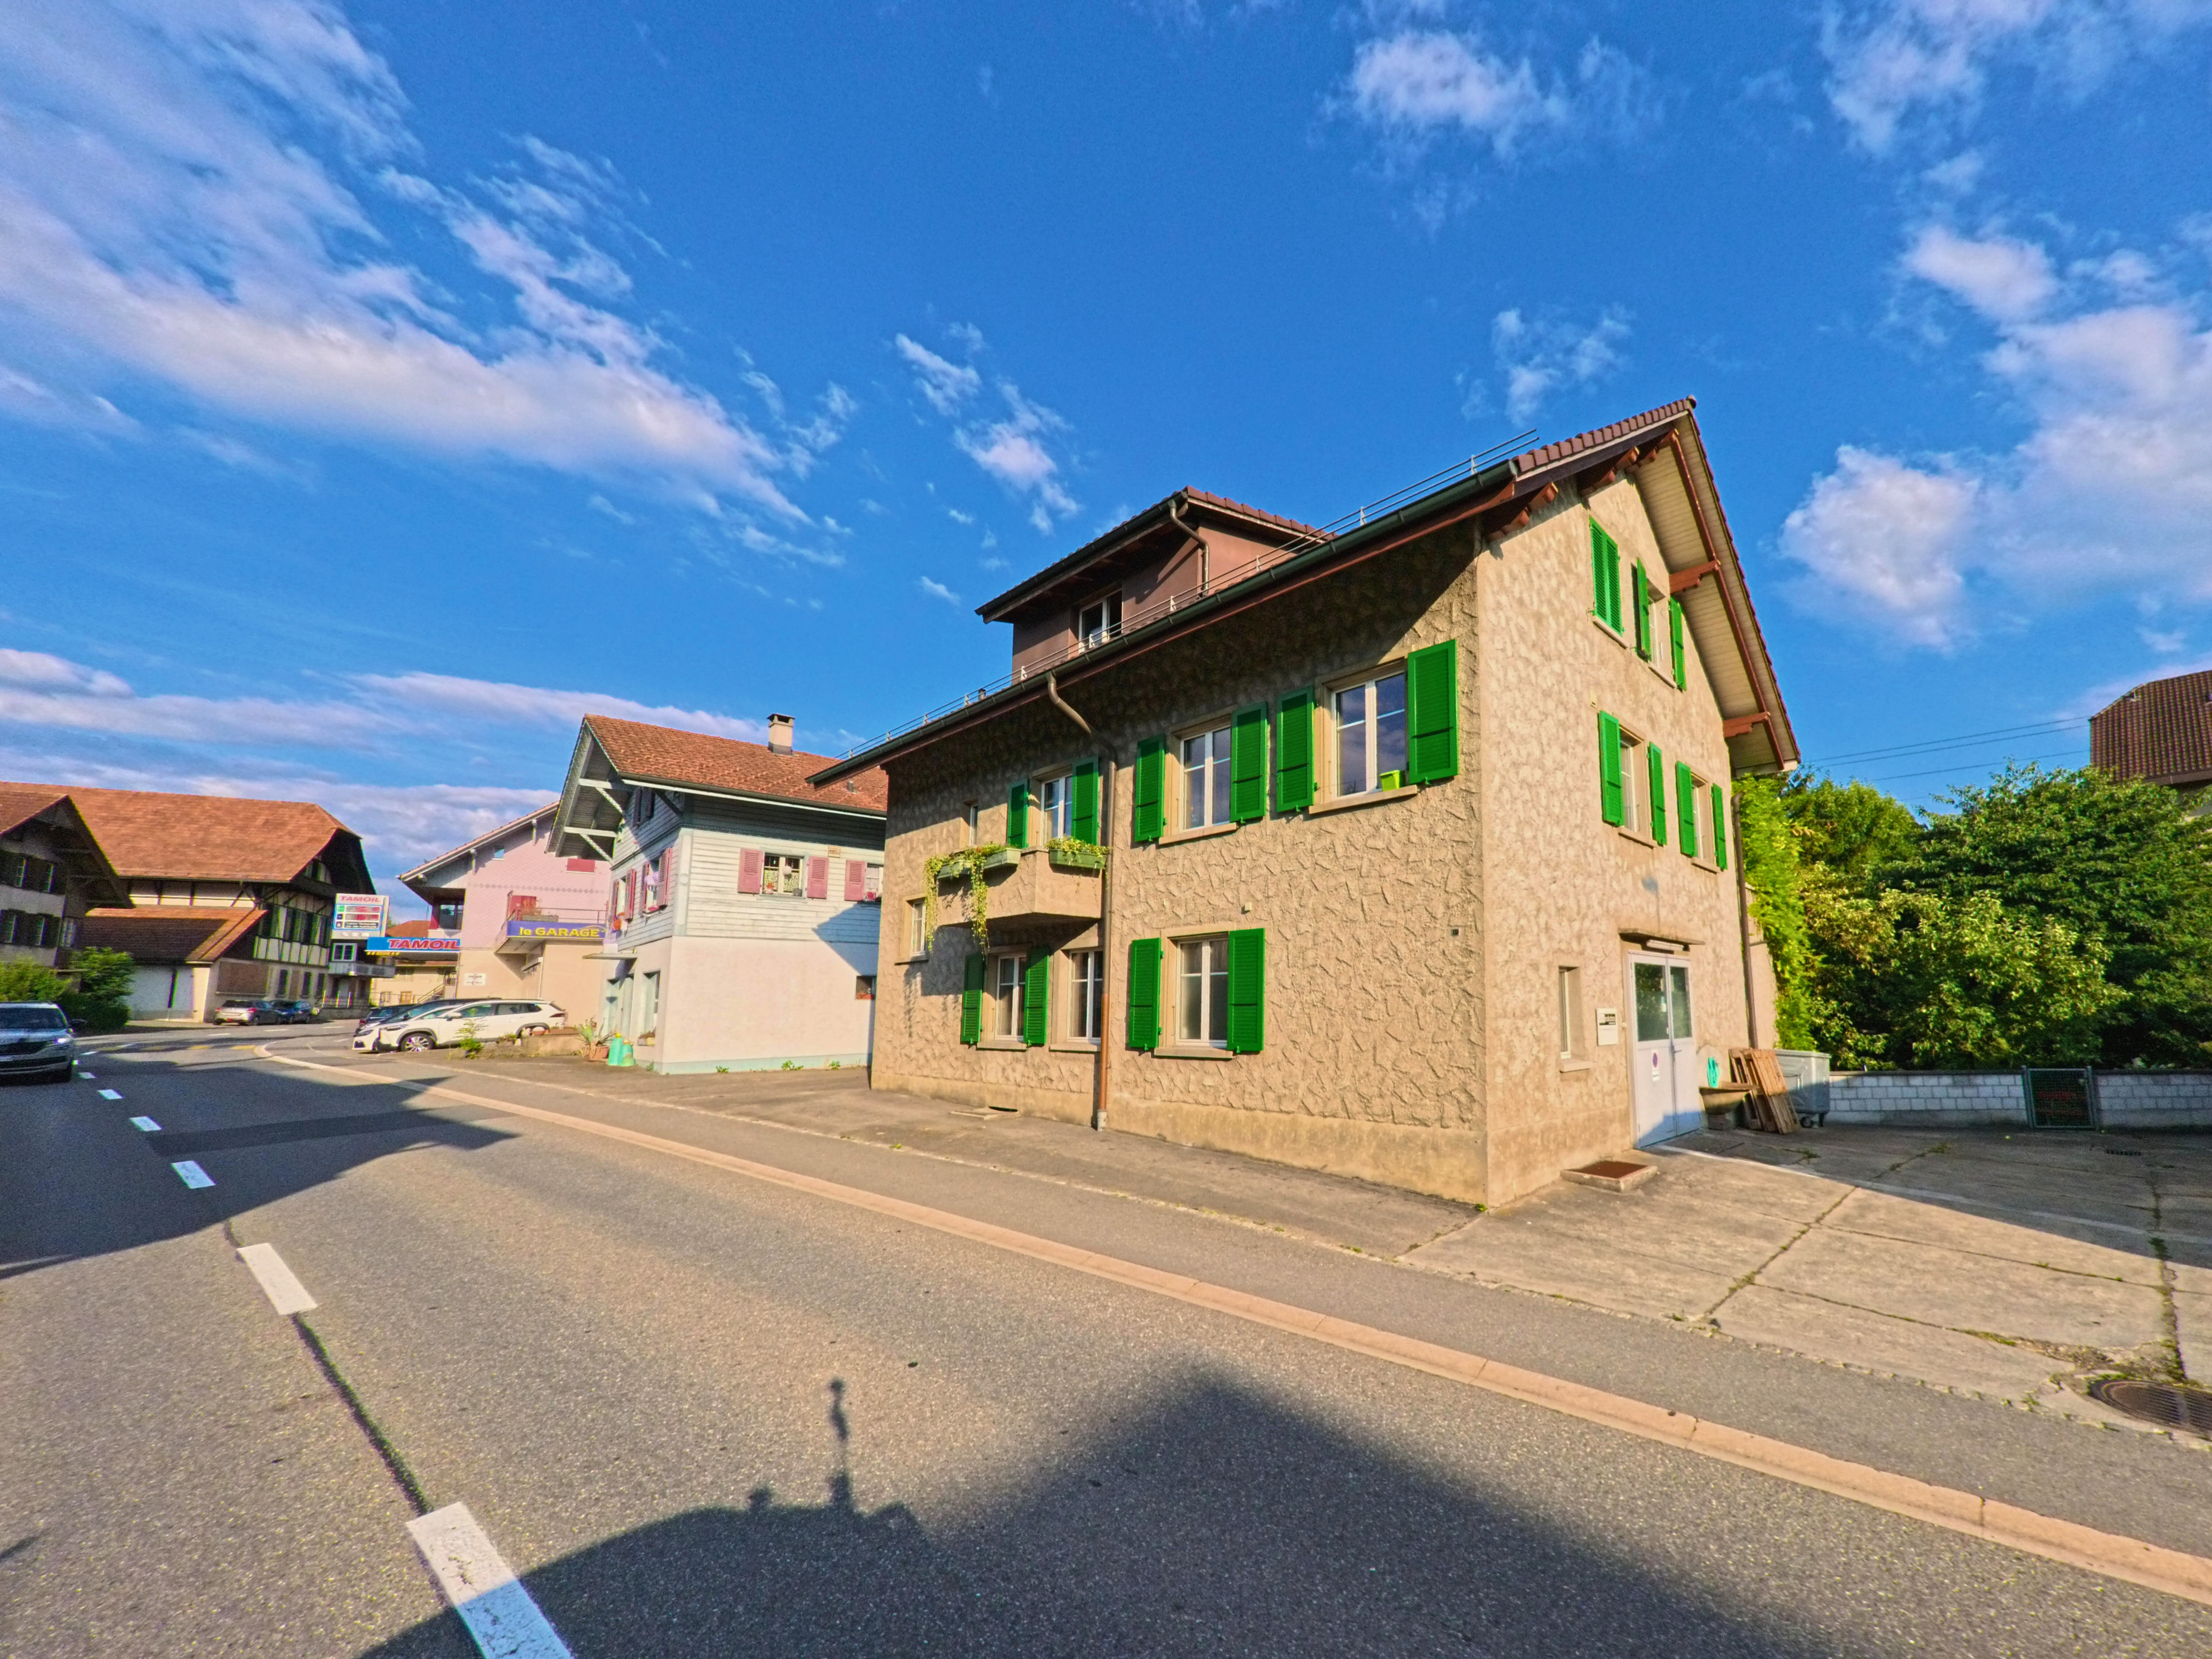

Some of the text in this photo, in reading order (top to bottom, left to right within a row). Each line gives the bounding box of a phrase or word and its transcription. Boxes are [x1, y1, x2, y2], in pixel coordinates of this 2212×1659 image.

[520, 927, 599, 937] le GARAGE
[388, 939, 461, 950] TAMOIL
